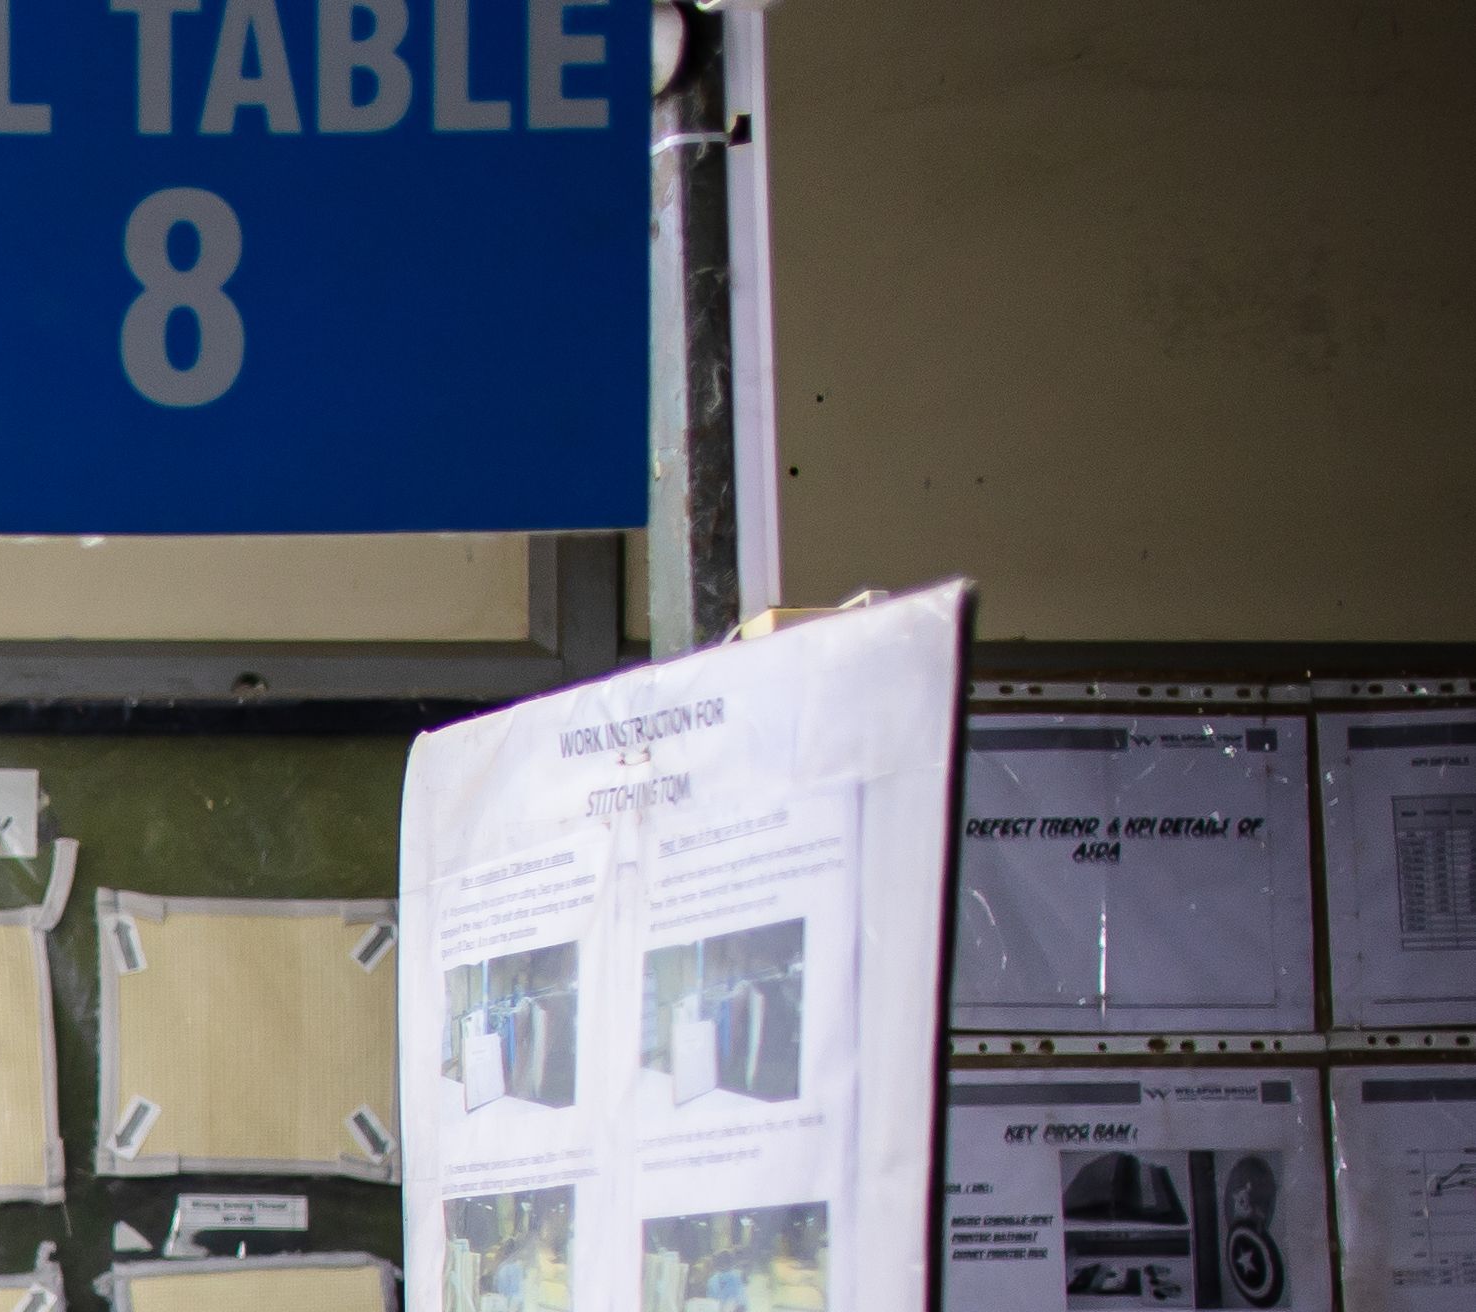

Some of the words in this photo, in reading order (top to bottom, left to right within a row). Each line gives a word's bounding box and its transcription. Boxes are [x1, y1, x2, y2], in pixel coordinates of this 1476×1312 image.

[109, 0, 609, 134] TABLE
[121, 187, 245, 406] 8
[560, 725, 604, 759] WORK
[966, 816, 1036, 840] DEFECT
[1040, 816, 1101, 841] TREND
[1237, 817, 1265, 839] OF
[1004, 1124, 1039, 1145] KEY
